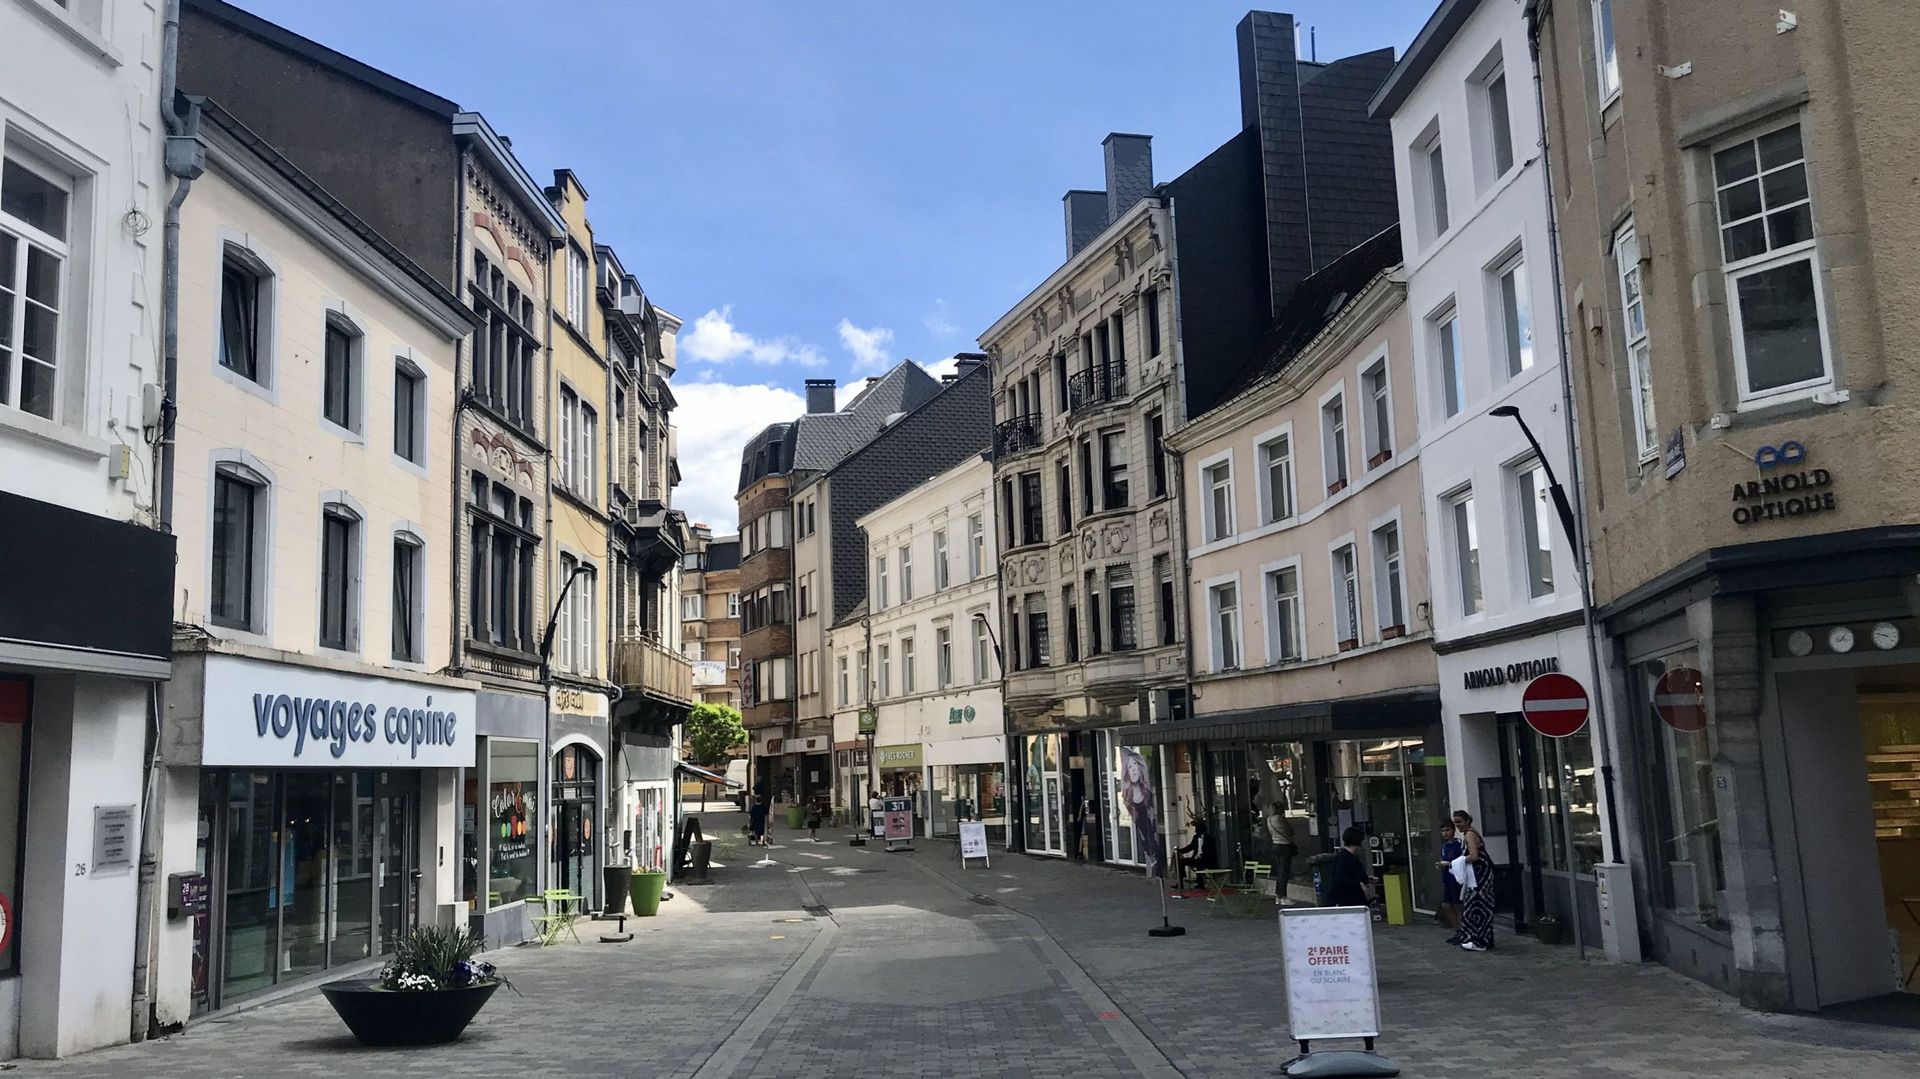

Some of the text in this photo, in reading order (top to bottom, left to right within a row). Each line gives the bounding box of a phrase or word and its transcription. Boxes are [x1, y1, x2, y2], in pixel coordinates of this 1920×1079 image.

[1732, 469, 1830, 501] ARNOLD
[1732, 492, 1836, 524] OPTIQUE
[743, 663, 753, 705] CAMY
[1464, 657, 1558, 690] ARNOLD OPTIQUE
[253, 693, 457, 759] voyages copine
[75, 863, 86, 877] 26
[1308, 956, 1350, 966] OFFERTE
[1319, 945, 1349, 956] PAIRE
[1323, 976, 1351, 984] SOLAIRE
[1324, 969, 1347, 977] BLANC
